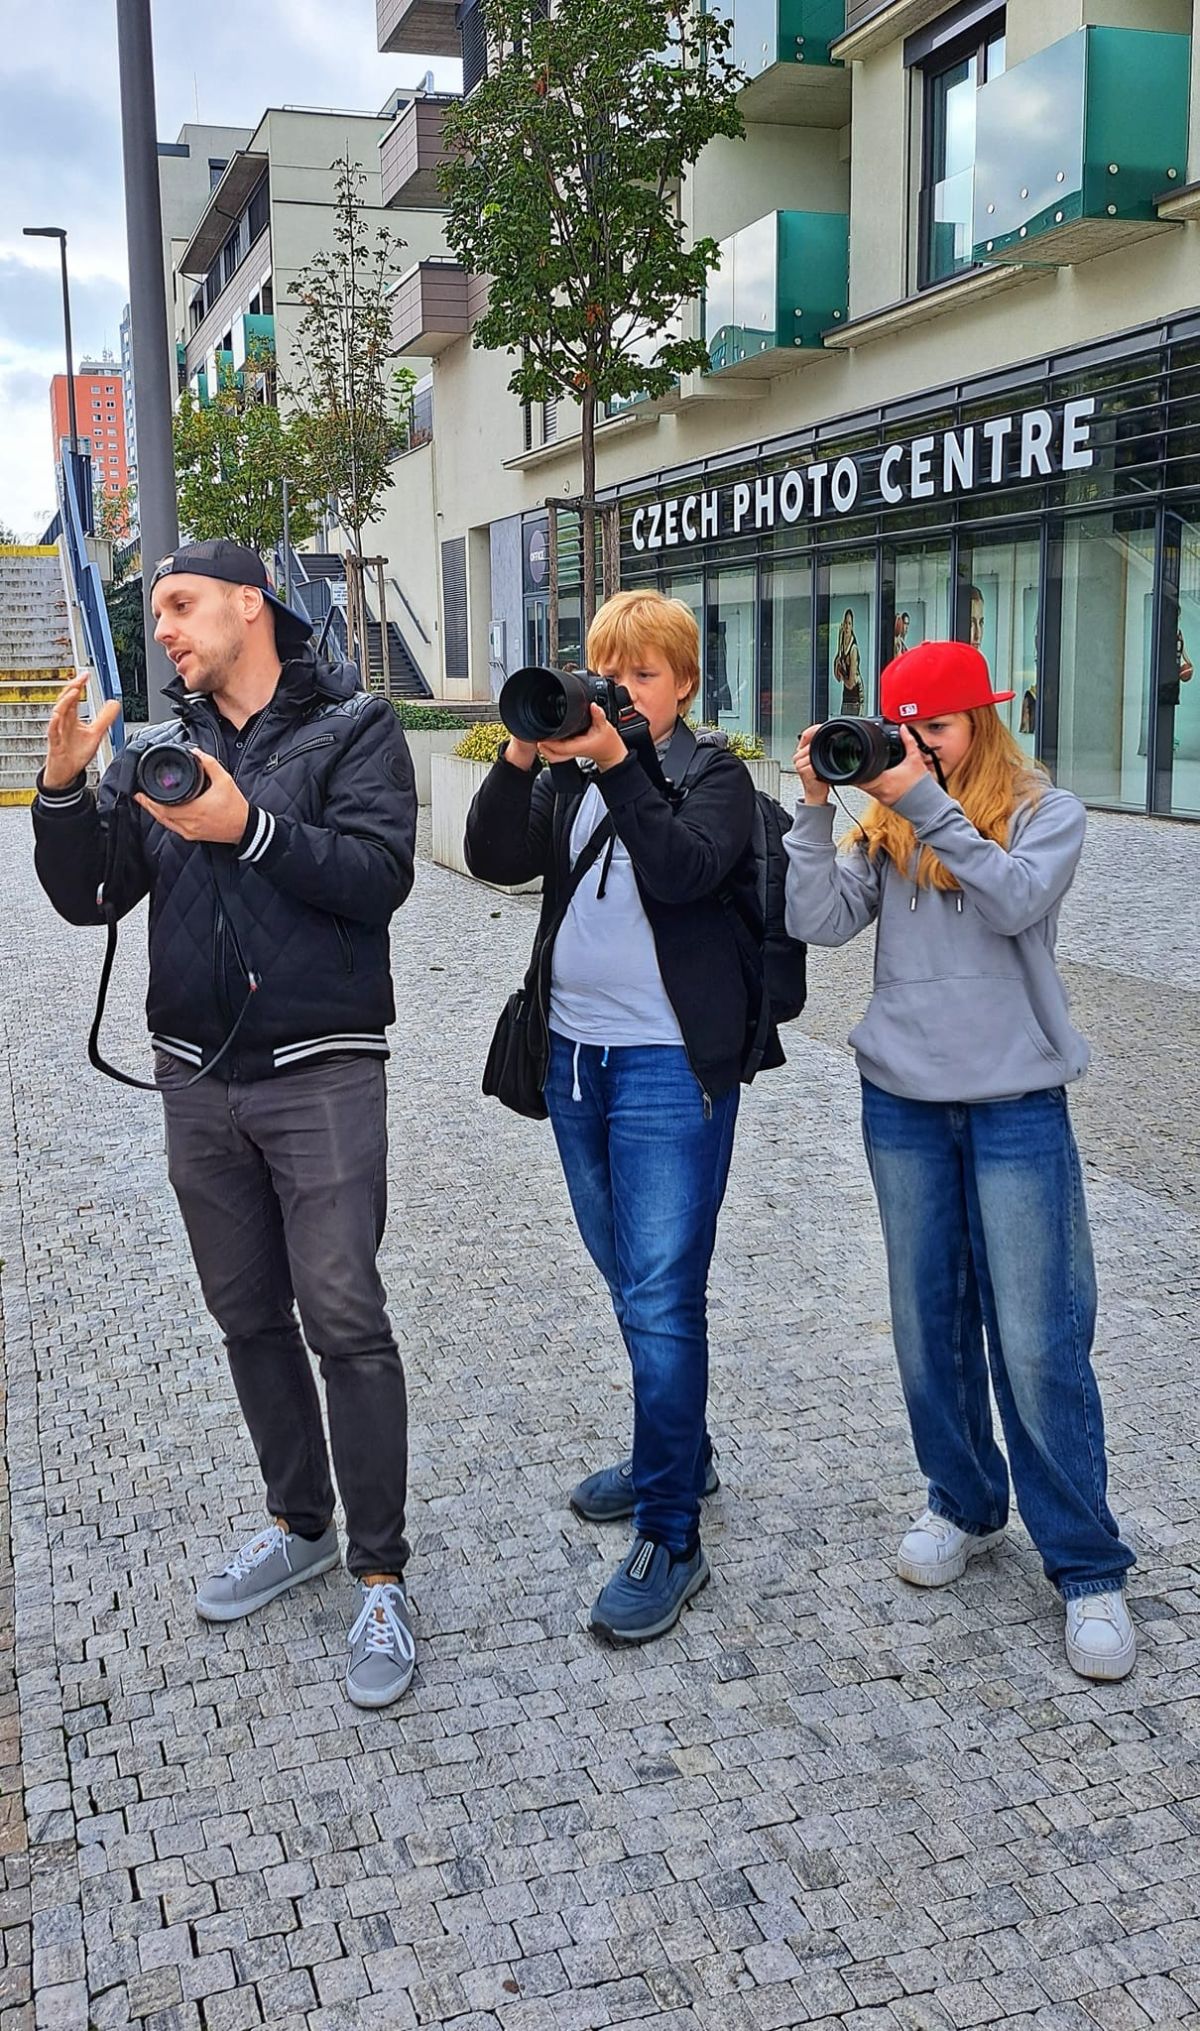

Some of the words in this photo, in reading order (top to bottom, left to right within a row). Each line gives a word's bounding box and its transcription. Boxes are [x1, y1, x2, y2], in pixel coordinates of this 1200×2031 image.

[632, 490, 718, 550] CZECH
[733, 456, 858, 532] PHOTO
[879, 397, 1095, 504] CENTRE
